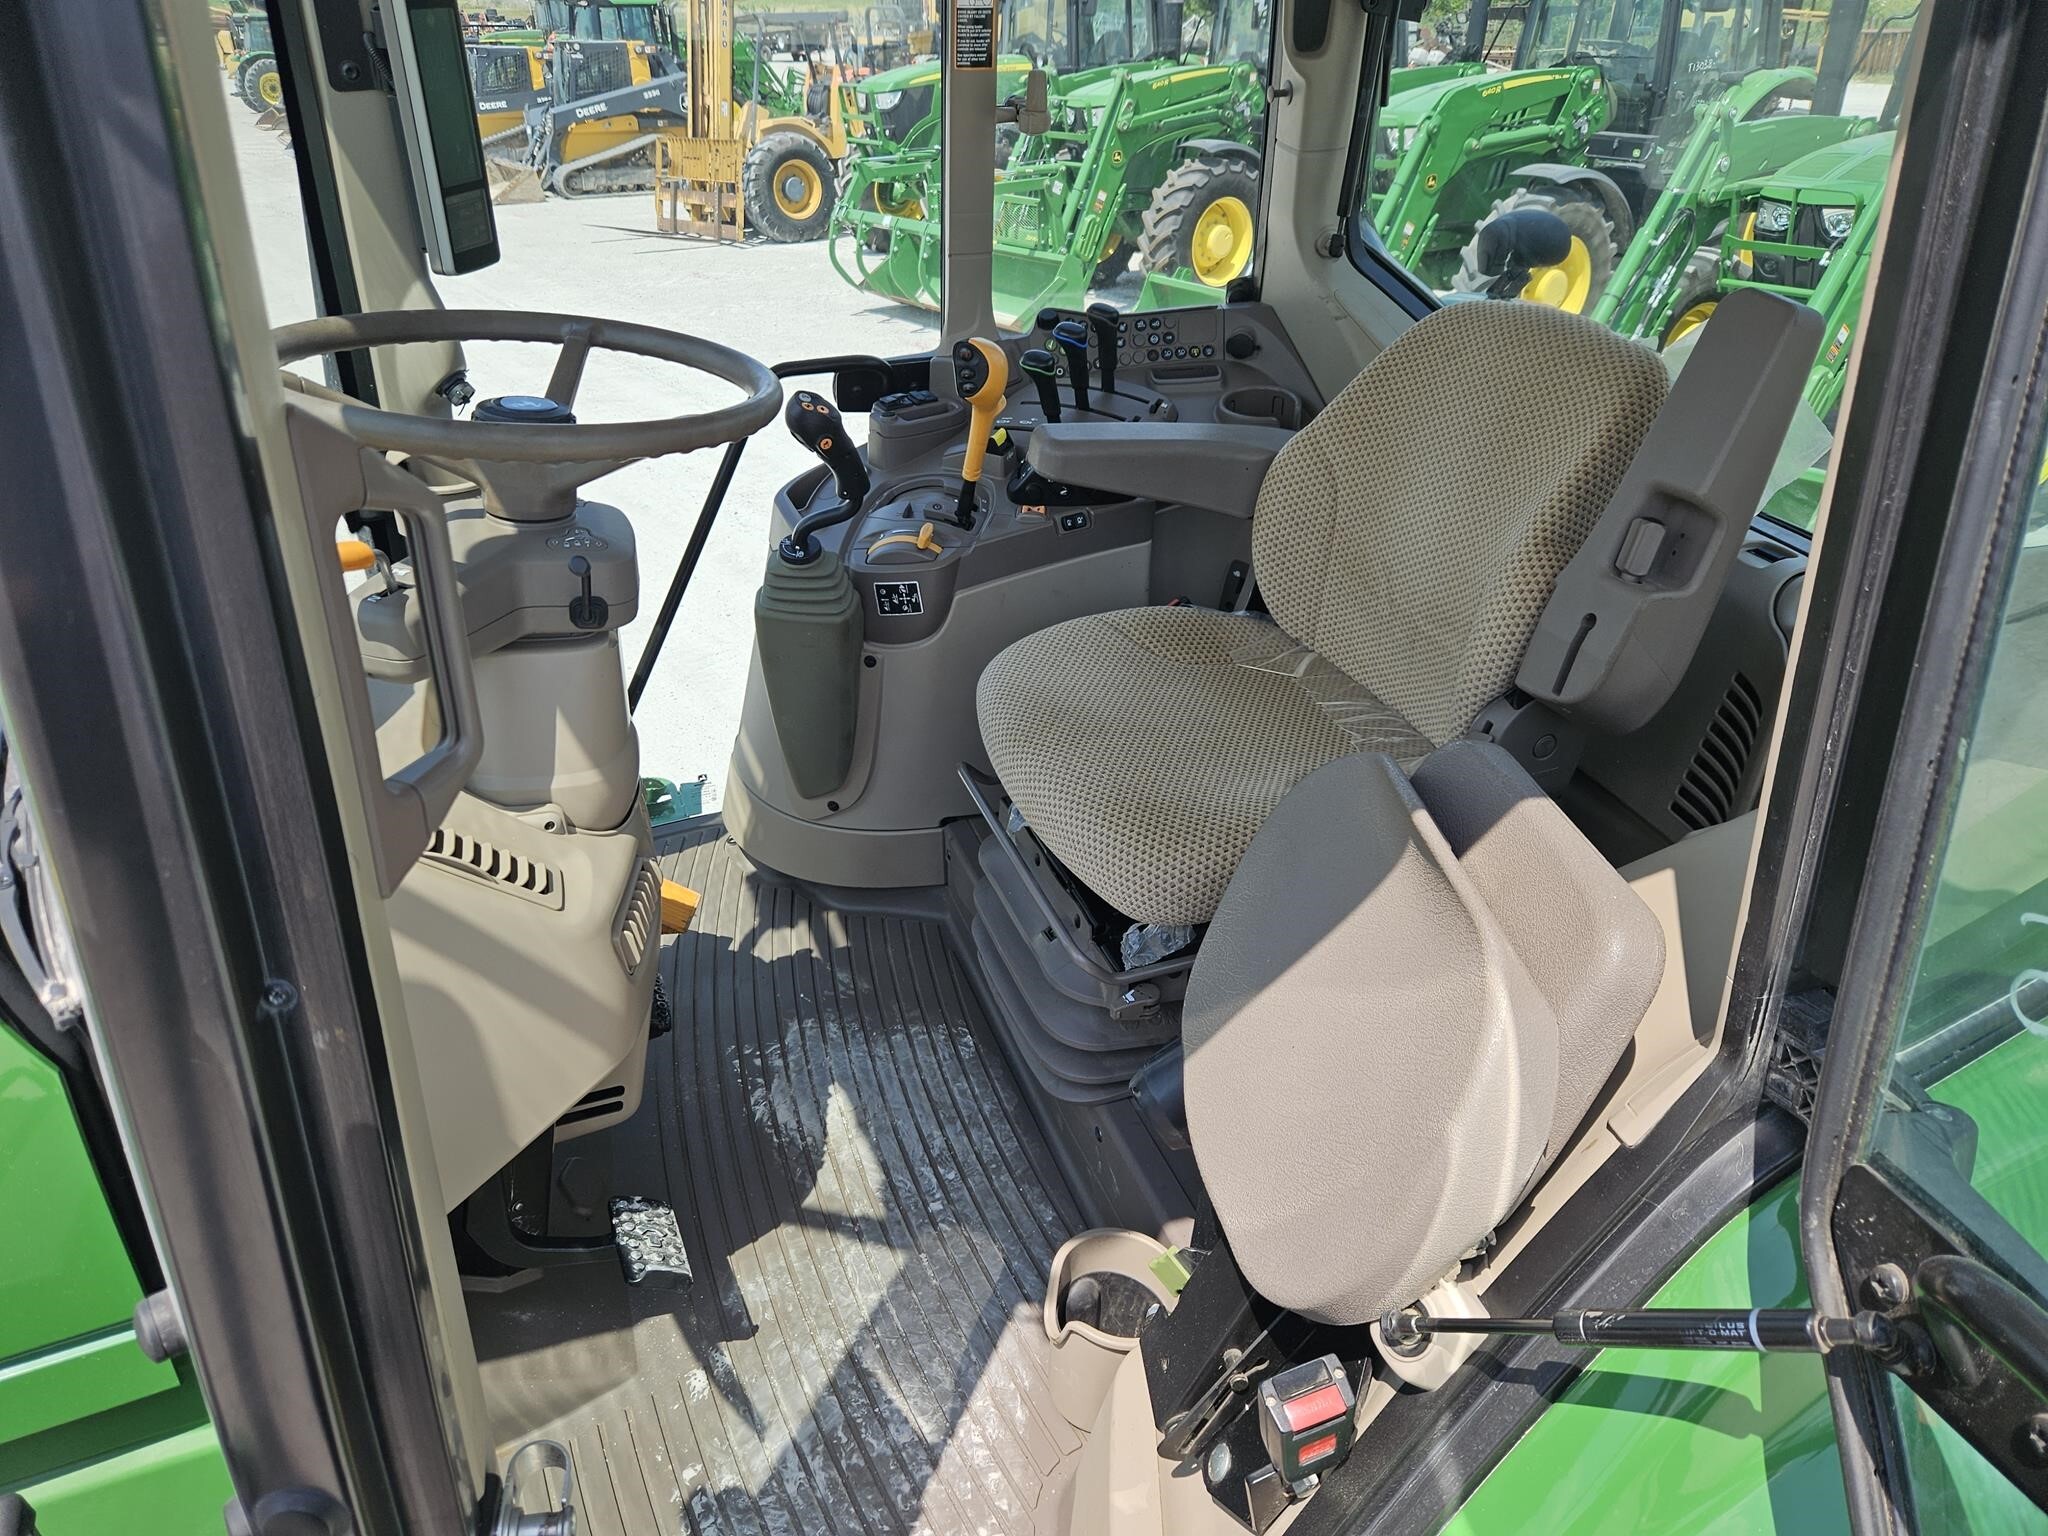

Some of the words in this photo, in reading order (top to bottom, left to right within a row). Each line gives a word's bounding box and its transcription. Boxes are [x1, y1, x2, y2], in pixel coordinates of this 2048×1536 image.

[1482, 86, 1502, 97] 640R
[479, 100, 508, 110] DEERE
[575, 102, 608, 118] DEERE
